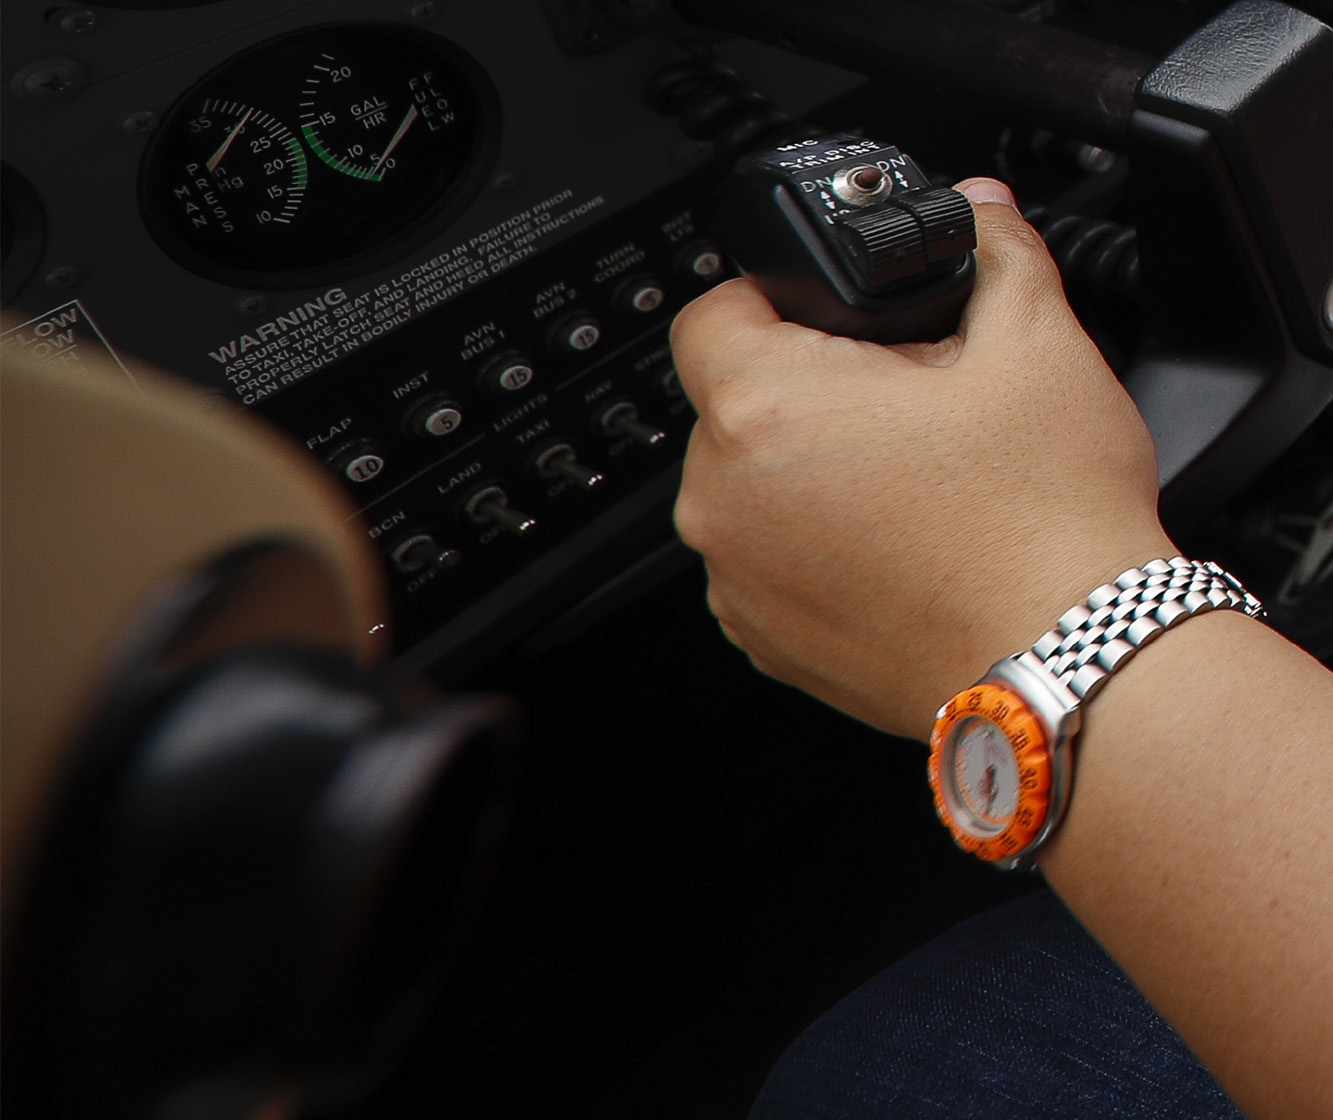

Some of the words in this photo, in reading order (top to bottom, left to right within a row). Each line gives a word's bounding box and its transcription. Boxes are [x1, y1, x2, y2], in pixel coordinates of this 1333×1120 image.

[330, 66, 352, 83] 20
[350, 96, 388, 117] GAL
[319, 111, 338, 127] 15
[362, 112, 388, 130] HR
[250, 136, 273, 154] 25
[348, 143, 365, 160] 10
[776, 139, 820, 153] MIC
[263, 158, 286, 176] 20
[384, 157, 397, 170] 0
[875, 155, 907, 173] DN
[217, 176, 246, 194] Hg
[267, 183, 284, 200] 15
[800, 176, 834, 194] DN
[255, 210, 273, 225] 10
[593, 248, 648, 284] COORD
[595, 241, 637, 270] TURN
[224, 335, 291, 377] ASSURE
[289, 314, 330, 341] THAT
[332, 291, 372, 318] SEAT
[374, 283, 390, 297] IS
[390, 252, 450, 289] LOCKED
[452, 242, 469, 257] IN
[469, 210, 532, 249] POSITION
[532, 188, 574, 216] PRIOR
[535, 281, 566, 305] AVN
[227, 368, 251, 385] TO
[373, 288, 406, 312] AND
[407, 255, 475, 292] LANDING.
[476, 221, 535, 256] FAILURE
[534, 211, 553, 227] TO
[234, 345, 320, 396] PROPERLY
[322, 318, 373, 350] LATCH
[375, 297, 411, 324] SEAT
[414, 280, 445, 301] AND
[445, 260, 485, 282] HEED
[487, 246, 513, 264] ALL
[513, 195, 606, 249] INSTRUCTIONS
[532, 296, 566, 320] BUS
[208, 286, 349, 365] WARNING
[241, 381, 279, 406] CAN
[280, 348, 342, 386] RESULT
[341, 337, 361, 353] IN
[360, 310, 414, 343] BODILY
[414, 280, 466, 314] INJURY
[467, 269, 490, 286] OR
[490, 244, 538, 275] DEATH.
[463, 320, 496, 348] AVN
[459, 337, 496, 362] BUS
[391, 369, 433, 400] INST
[508, 370, 529, 386] 15
[584, 378, 614, 404] NAV
[441, 417, 455, 431] 5
[493, 392, 550, 432] LIGHTS
[306, 416, 352, 451] FLAP
[515, 417, 552, 445] TAXI
[353, 456, 380, 481] 10
[437, 461, 484, 496] LAND
[368, 510, 408, 540] BCN
